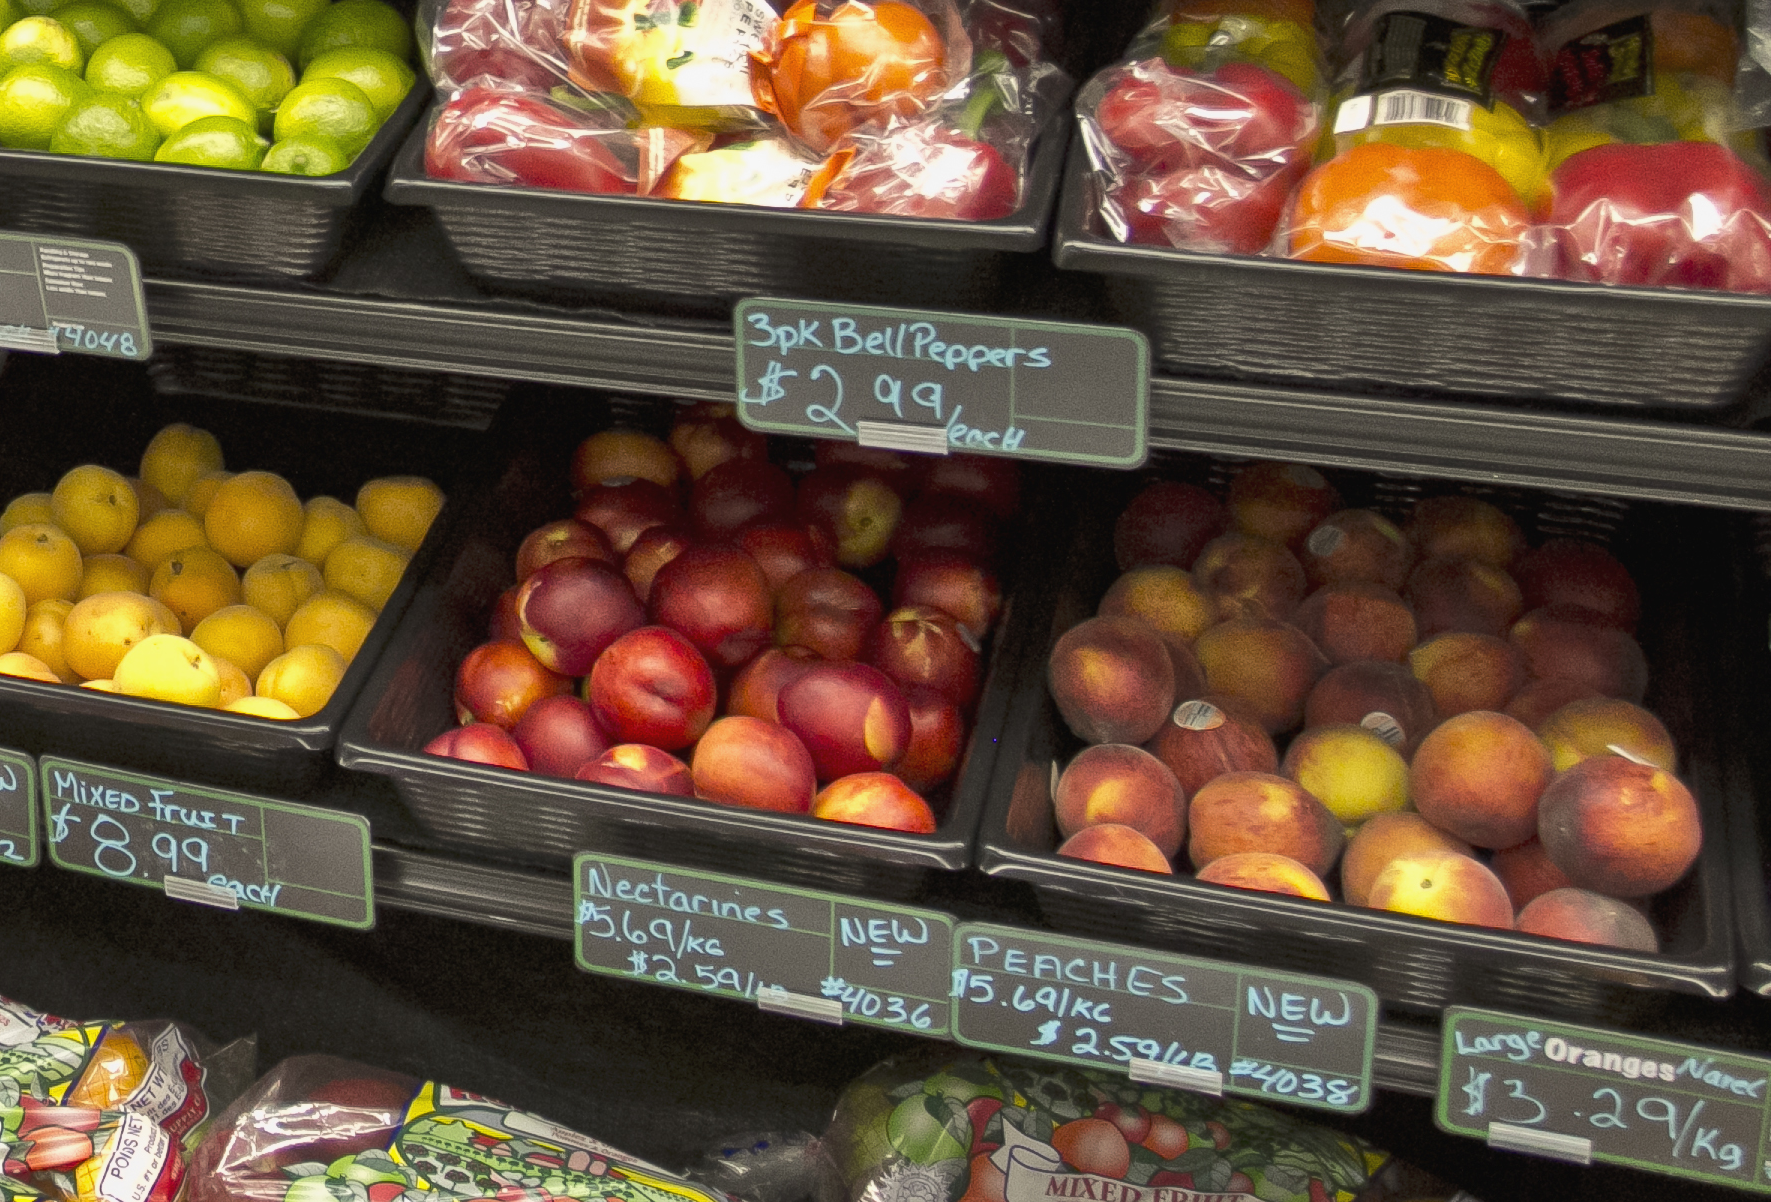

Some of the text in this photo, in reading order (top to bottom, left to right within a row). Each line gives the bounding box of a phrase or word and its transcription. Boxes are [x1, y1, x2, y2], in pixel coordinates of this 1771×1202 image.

[832, 317, 906, 358] Bell
[909, 322, 1053, 373] Peppers
[588, 862, 928, 947] Nectarines NEW
[820, 976, 932, 1029] #4036
[967, 936, 1351, 1027] PEACHES NEW
[1229, 1059, 1358, 1106] #4038
[1544, 1036, 1677, 1083] Oranges
[130, 1086, 157, 1112] NET
[111, 1115, 144, 1180] POIDS NET
[1045, 1176, 1142, 1202] MIXED
